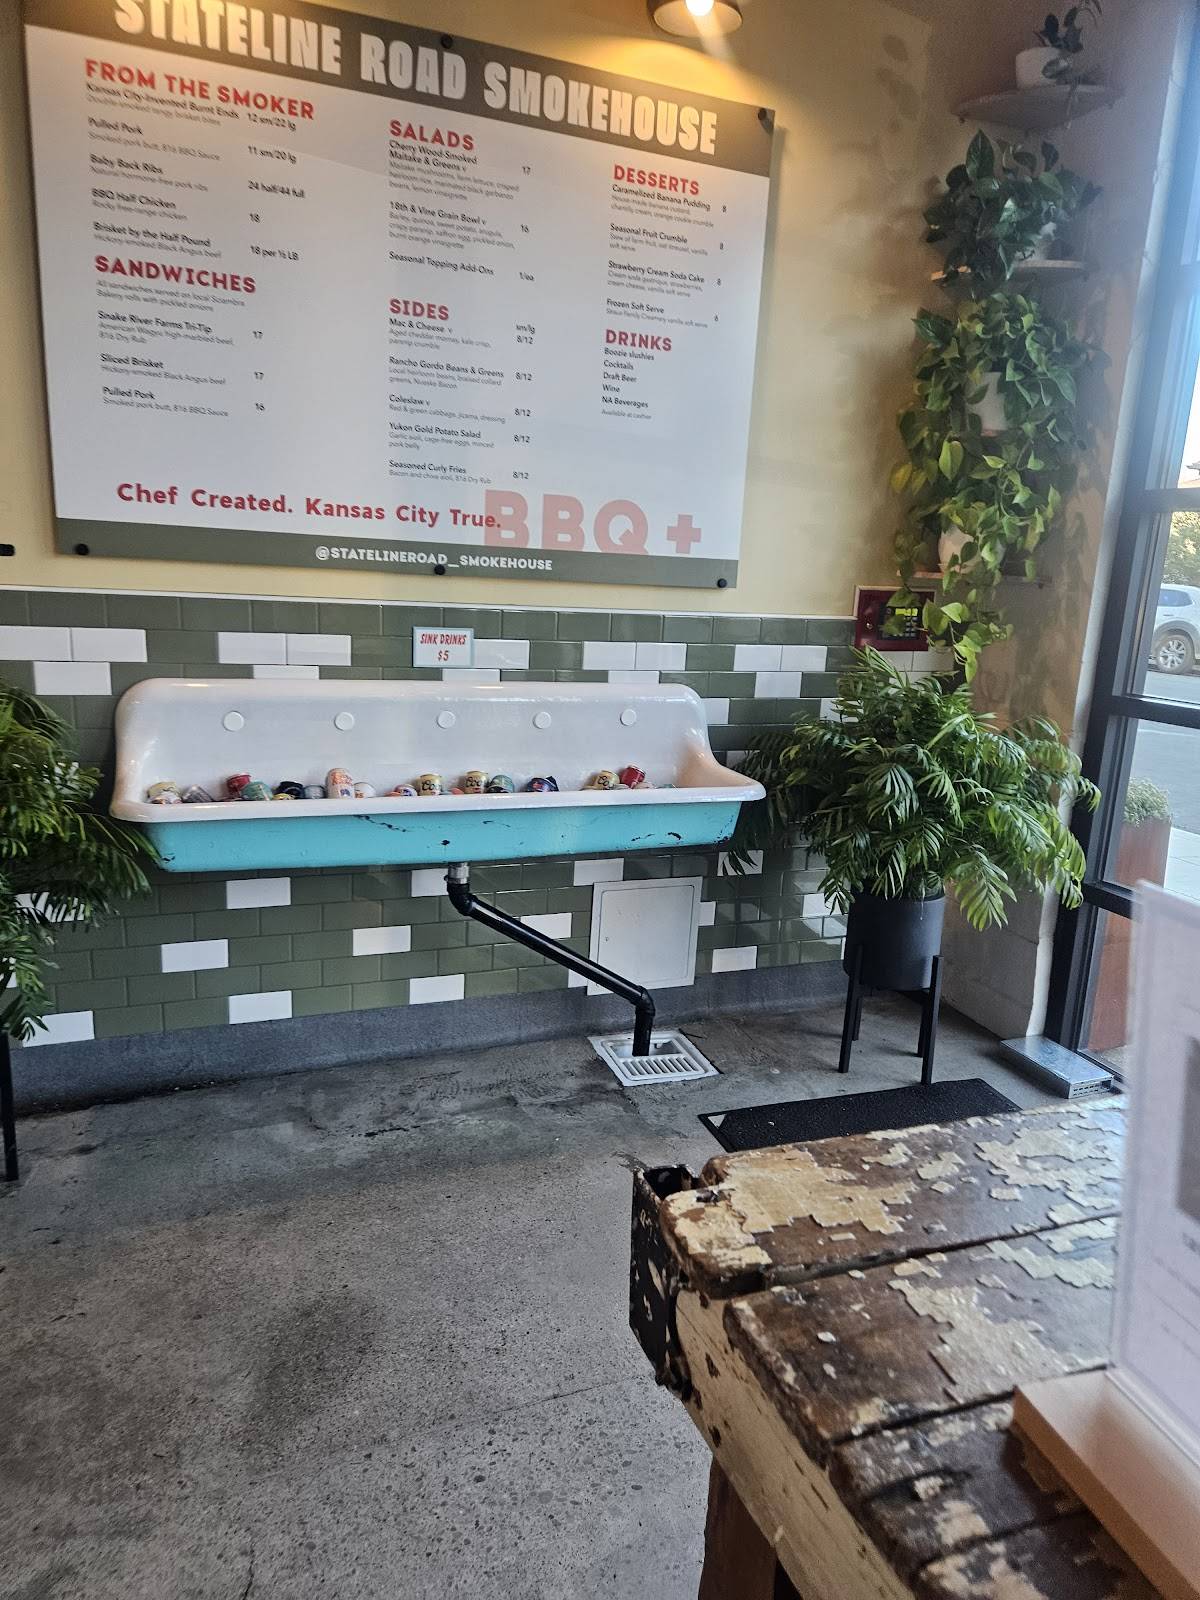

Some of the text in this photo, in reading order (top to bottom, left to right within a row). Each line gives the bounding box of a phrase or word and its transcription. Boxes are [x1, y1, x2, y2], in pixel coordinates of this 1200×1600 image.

[85, 59, 155, 89] FROM
[165, 74, 209, 99] THE
[217, 85, 313, 119] SMOKER
[113, 0, 718, 155] STATELINE ROAD SMOKEHOUSE
[86, 82, 120, 96] Kansas
[189, 101, 214, 114] Burnt
[216, 106, 239, 118] Ends
[247, 112, 257, 122] 12
[287, 120, 296, 131] lg
[88, 116, 119, 130] Pulled
[121, 122, 142, 134] Pork
[247, 145, 257, 154] 11
[288, 152, 296, 164] lg
[390, 120, 473, 150] SALADS
[389, 139, 416, 154] Cherry
[522, 166, 531, 174] 17
[389, 149, 421, 163] Maitake
[423, 156, 430, 165] &
[432, 158, 460, 170] Greens
[90, 154, 114, 167] Baby
[117, 158, 140, 170] Back
[142, 162, 163, 174] Ribs
[248, 180, 259, 190] 24
[614, 164, 699, 195] DESSERTS
[92, 188, 260, 222] BBQ Half Chicken 18
[612, 183, 655, 199] Caramelized
[656, 192, 681, 204] Banana
[683, 197, 710, 211] Pudding
[390, 201, 408, 211] 18th
[410, 204, 416, 213] &
[417, 206, 435, 216] Vine
[437, 209, 458, 220] Grain
[460, 213, 480, 223] Bowl
[520, 224, 529, 232] 16
[93, 221, 126, 234] Brisket
[128, 226, 140, 238] by
[142, 229, 158, 239] the
[160, 232, 179, 241] Half
[181, 234, 210, 247] Pound
[250, 245, 260, 254] 18
[287, 251, 298, 260] LB
[610, 223, 641, 234] Seasonal
[642, 228, 657, 238] Fruit
[659, 232, 687, 243] Crumble
[95, 255, 255, 293] SANDWICHES
[389, 251, 424, 264] Seasonal
[426, 257, 458, 271] Topping
[459, 263, 493, 274] Add-Ons
[608, 260, 645, 274] Strawberry
[646, 266, 668, 276] Cream
[670, 270, 687, 280] Soda
[688, 273, 704, 282] Cake
[390, 298, 448, 320] SIDES
[606, 298, 629, 308] Frozen
[631, 302, 644, 310] Soft
[645, 304, 664, 313] Serve
[98, 310, 126, 322] Snake
[129, 314, 152, 324] River
[155, 317, 182, 329] Farms
[184, 321, 212, 334] Tri-Tip
[389, 318, 405, 327] Mac
[415, 321, 444, 332] Cheese
[516, 335, 533, 344] 8/12
[605, 329, 671, 351] DRINKS
[603, 359, 633, 370] Cocktails
[604, 347, 654, 360] Boozie slushies
[100, 353, 264, 379] Sliced Brisket 17
[389, 356, 418, 367] Rancho
[419, 360, 444, 370] Gordo
[445, 363, 468, 373] Beans
[477, 367, 504, 377] Greens
[515, 372, 532, 381] 8/12
[603, 371, 636, 382] Draft Beer
[102, 386, 265, 411] Pulled Pork 16
[602, 384, 620, 392] Wine
[389, 394, 423, 404] Coleslaw
[514, 408, 530, 417] 8/12
[614, 397, 648, 408] Beverages
[389, 422, 530, 443] Yukon Gold Potato Salad 8/12
[389, 460, 528, 479] Seasoned Curly Fries 8/12
[117, 483, 502, 529] Chef Created. Kansas City True.
[420, 634, 467, 646] SINK DRINKS
[438, 650, 449, 662] $5
